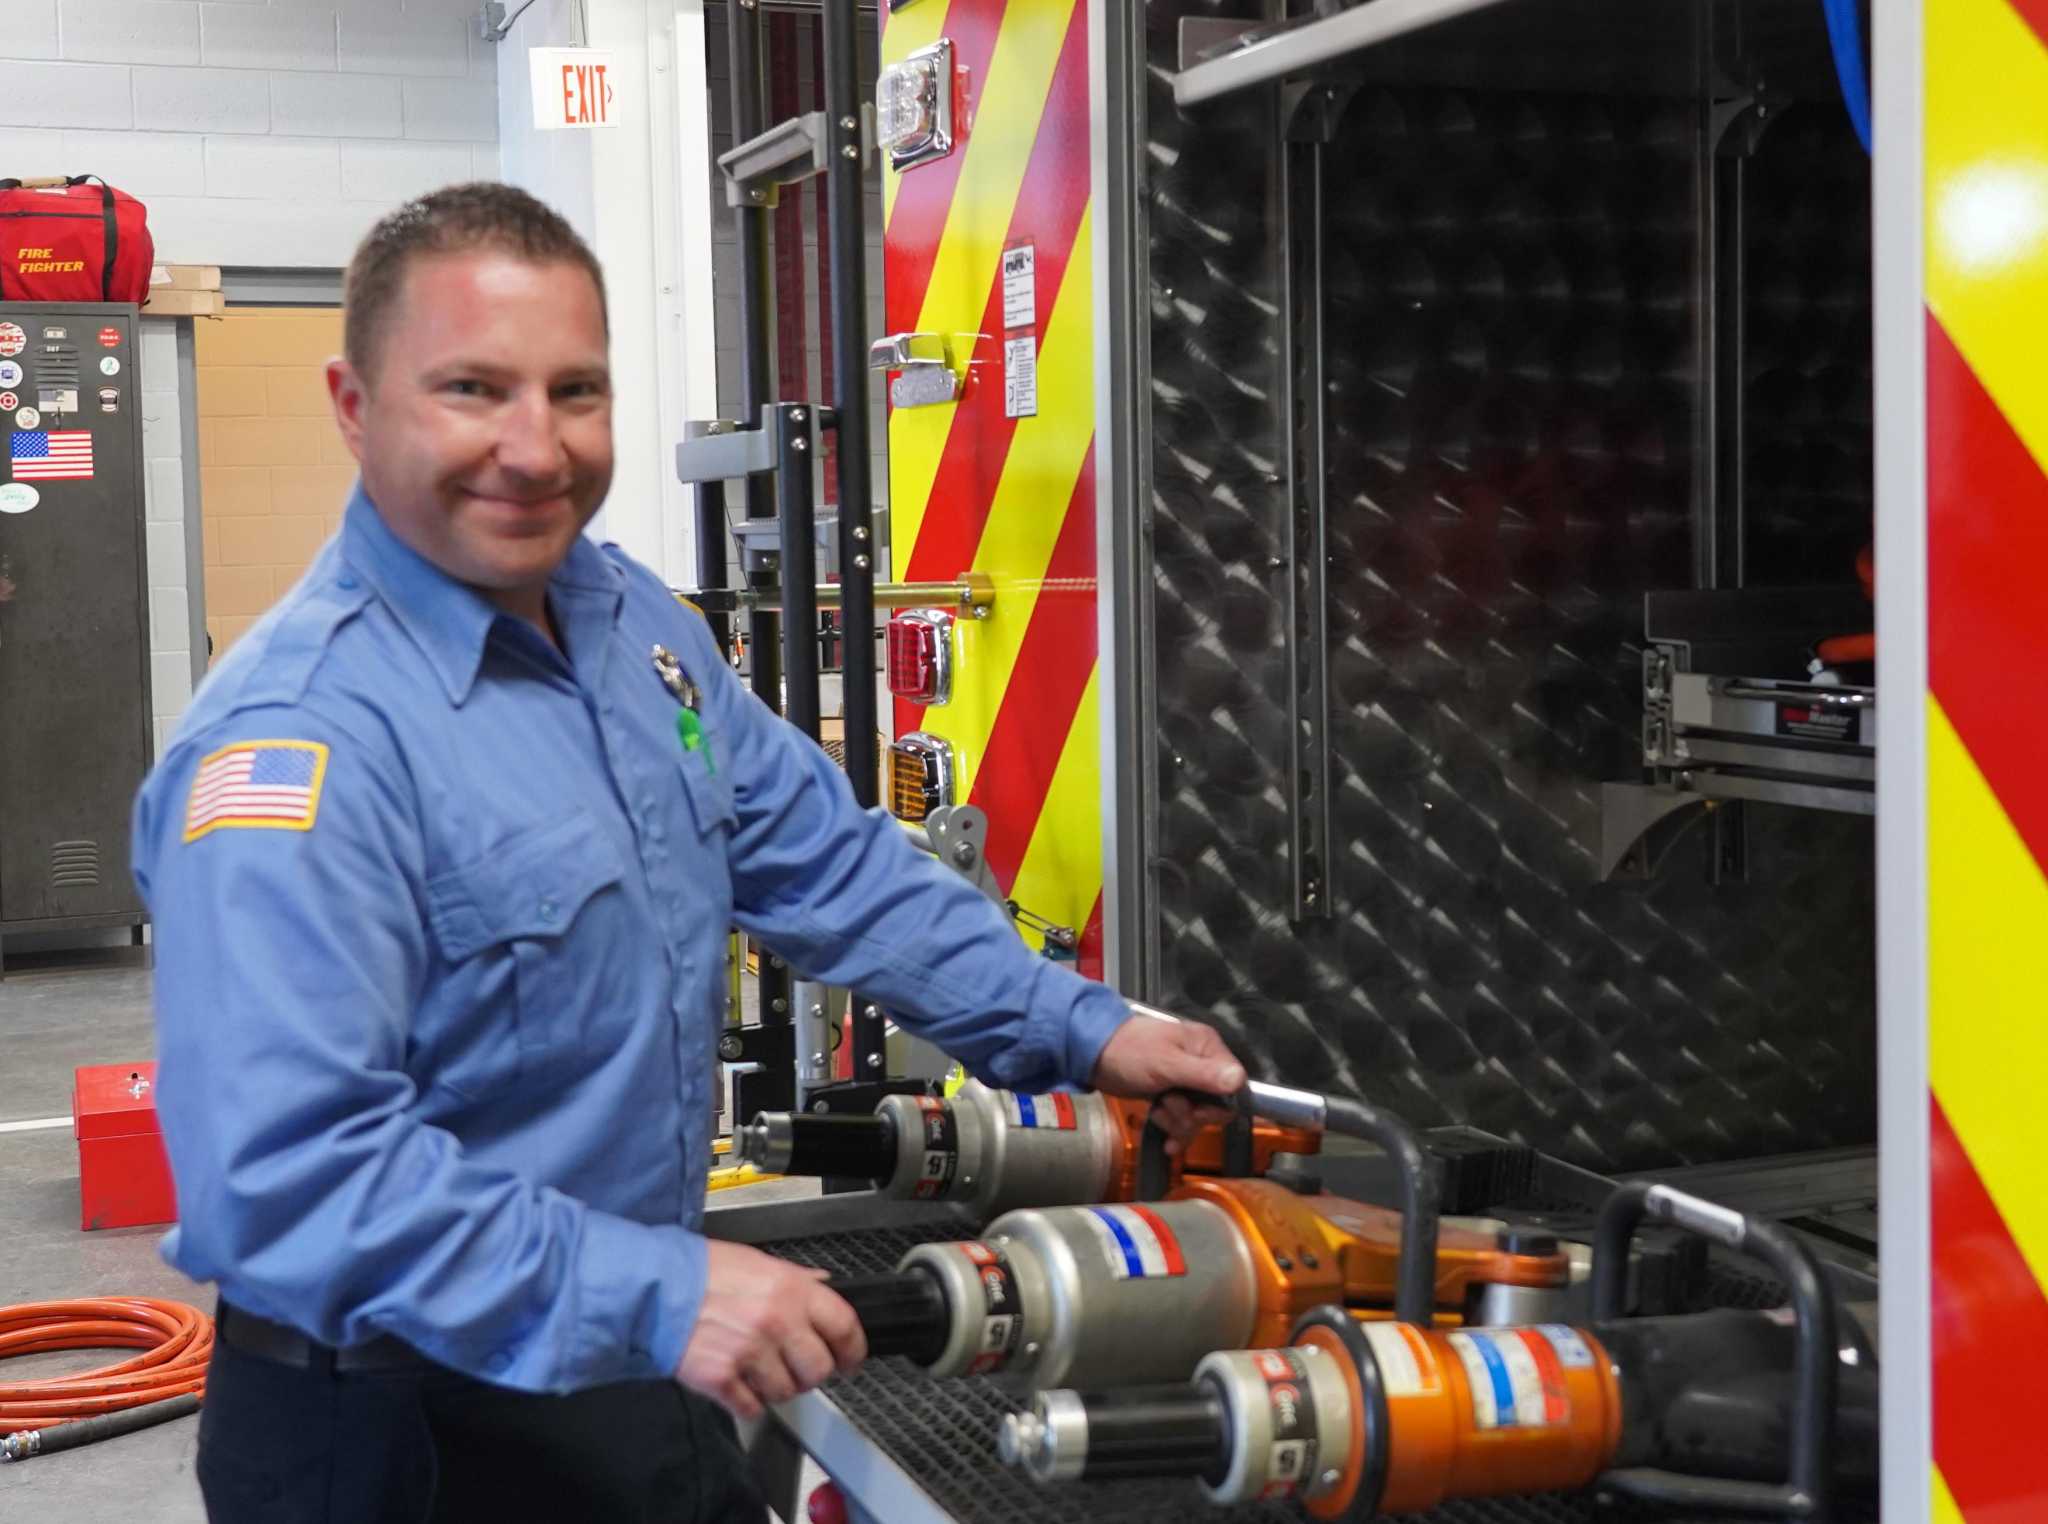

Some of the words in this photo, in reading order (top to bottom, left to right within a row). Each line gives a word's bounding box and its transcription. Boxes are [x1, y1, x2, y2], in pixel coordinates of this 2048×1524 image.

[562, 64, 606, 124] EXIT
[17, 248, 53, 260] FIRE
[19, 261, 84, 274] FIGHTER
